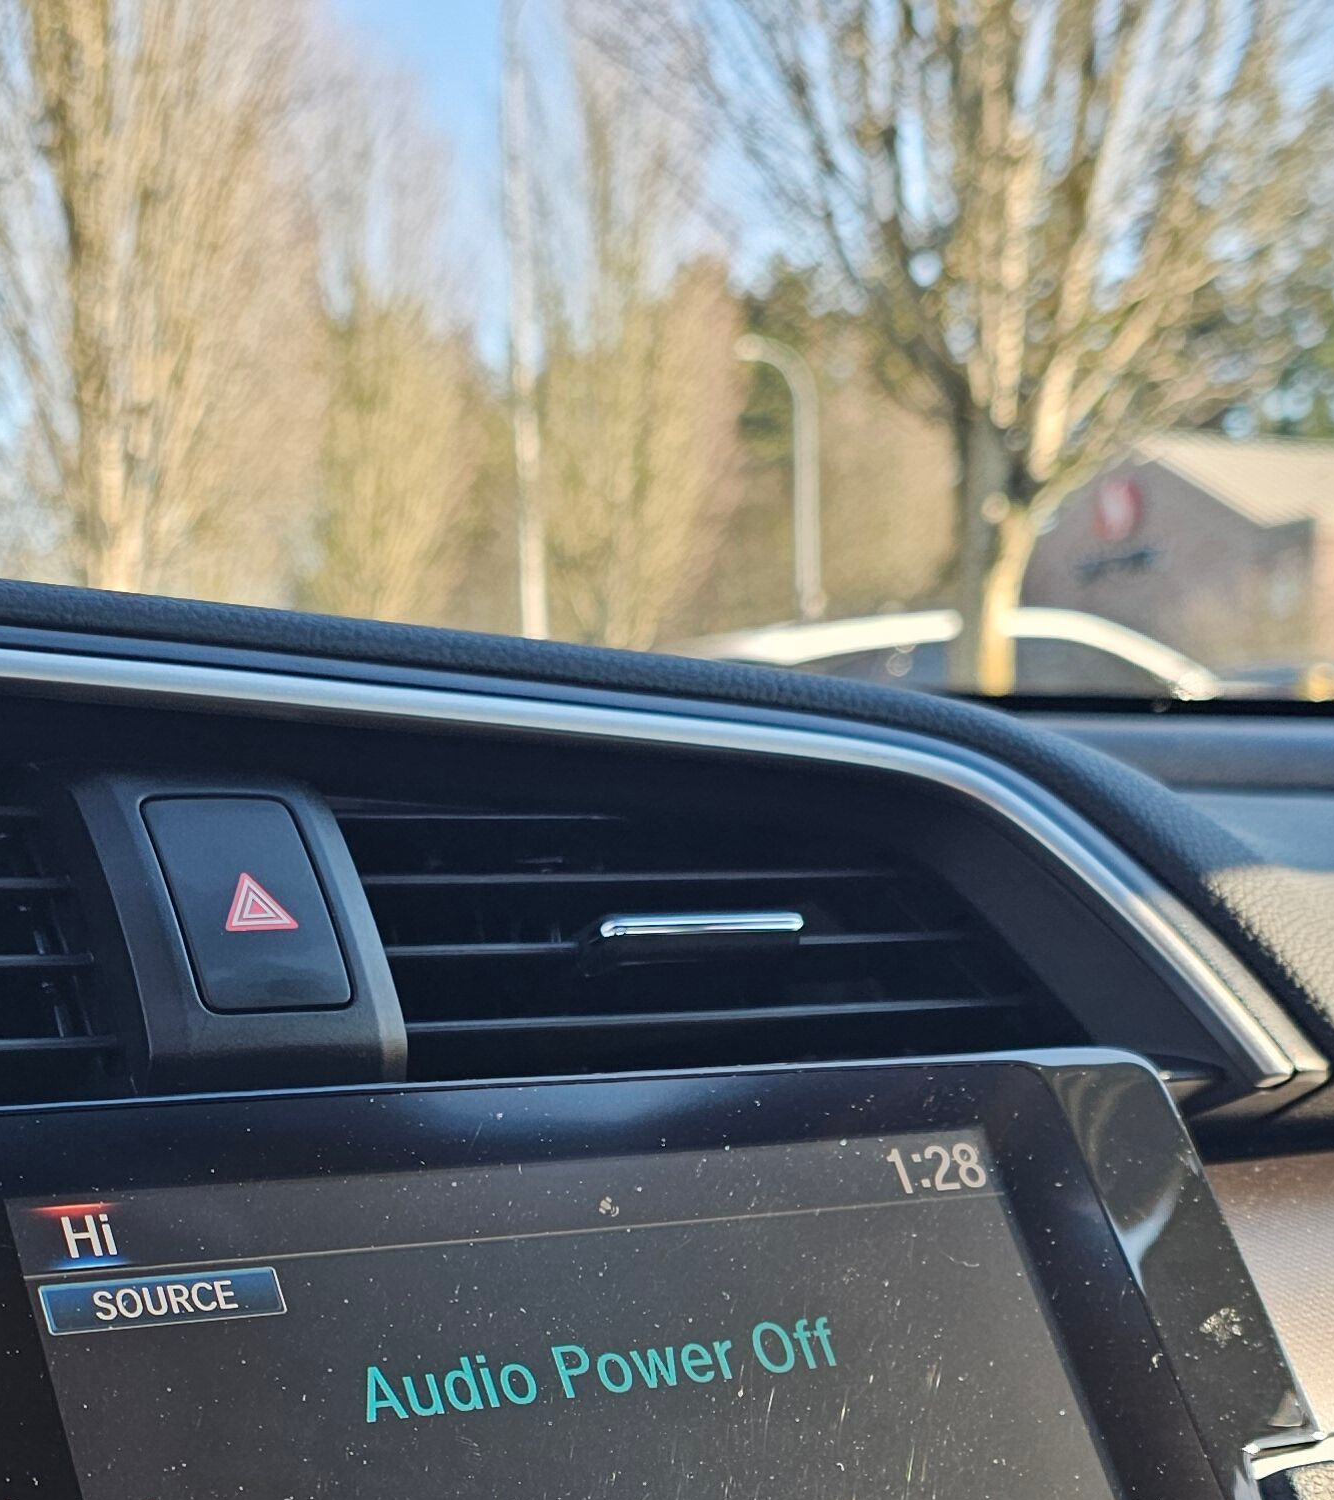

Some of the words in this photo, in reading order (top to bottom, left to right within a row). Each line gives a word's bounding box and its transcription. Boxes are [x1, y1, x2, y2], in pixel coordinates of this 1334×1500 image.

[886, 1141, 987, 1195] 1:28
[60, 1214, 119, 1260] Hi
[92, 1279, 239, 1322] SOURCE
[366, 1354, 538, 1424] Audio
[551, 1339, 734, 1400] Power
[751, 1316, 838, 1375] Off
